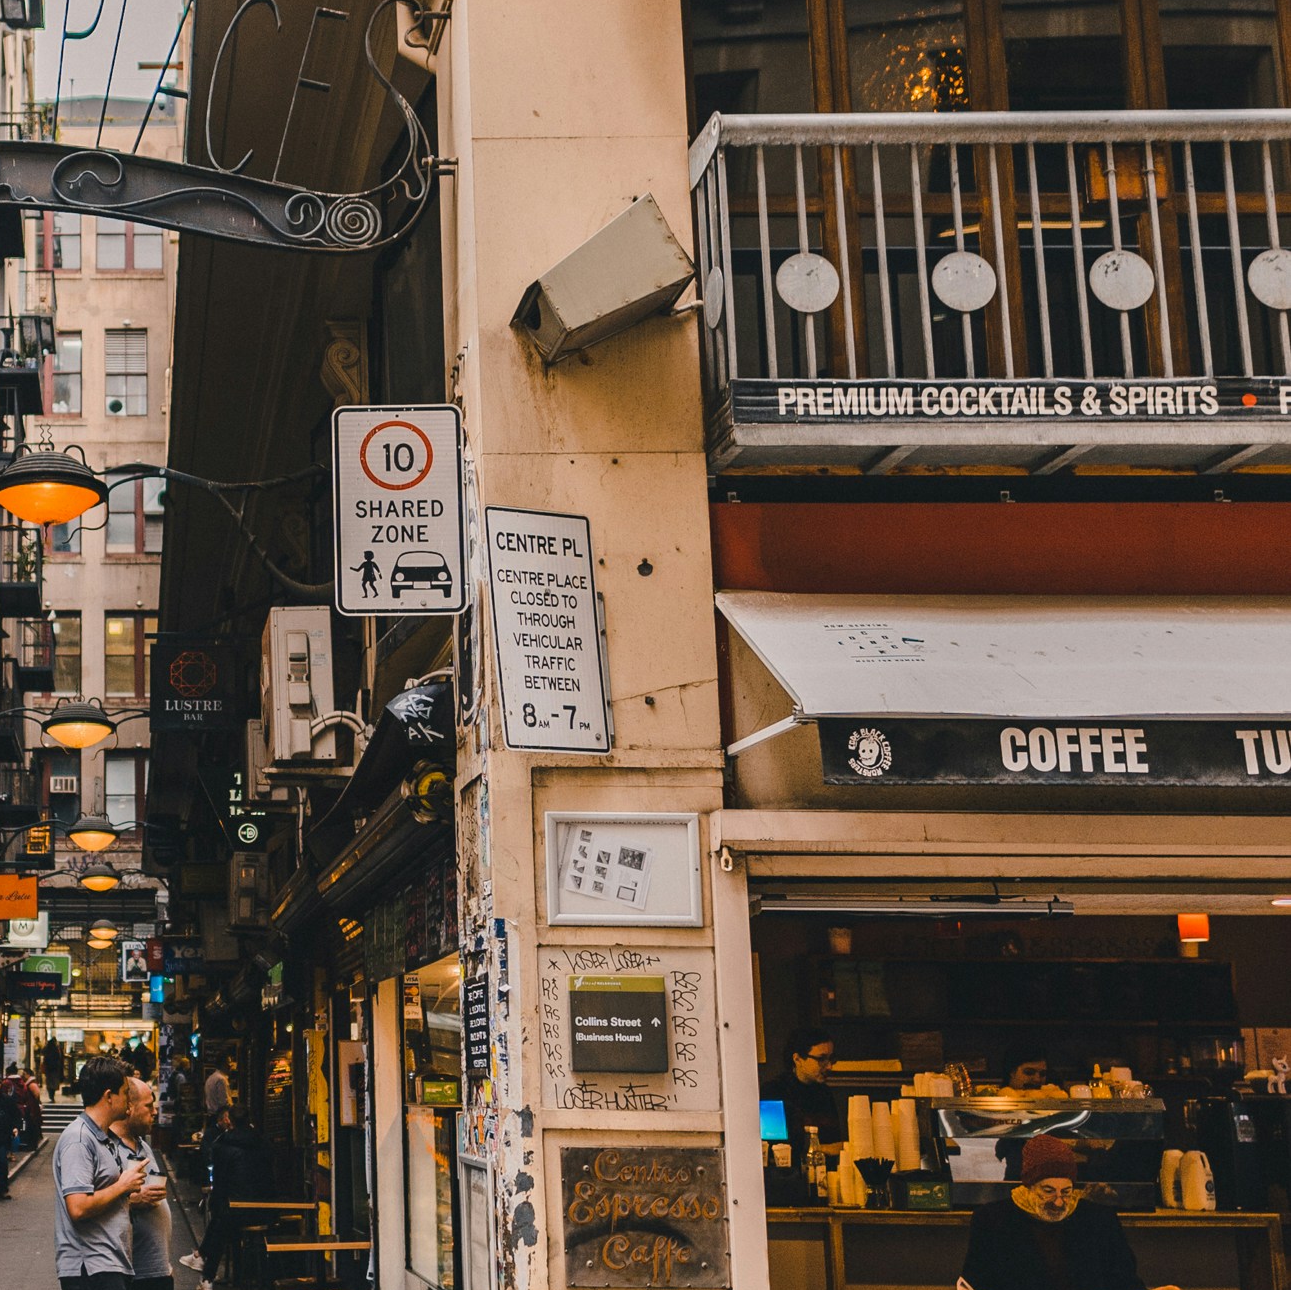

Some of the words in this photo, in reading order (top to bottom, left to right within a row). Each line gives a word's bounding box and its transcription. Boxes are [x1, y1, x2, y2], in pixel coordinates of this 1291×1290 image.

[778, 387, 914, 415] PREMIUM
[921, 386, 1072, 415] COCKTAILS
[1080, 386, 1103, 415] &
[1109, 386, 1219, 415] SPIRITS
[383, 443, 414, 472] 10
[355, 500, 444, 518] SHARED
[371, 525, 429, 543] ZONE
[496, 531, 557, 555] CENTRE
[562, 537, 583, 558] PL
[497, 569, 545, 586] CENTRE
[547, 573, 587, 589] PLACE
[510, 590, 559, 608] CLOSED
[561, 594, 578, 609] TO
[516, 611, 576, 629] THROUGH
[512, 632, 583, 651] VEHICULAR
[524, 655, 576, 671] TRAFFIC
[524, 675, 581, 692] BETWEEN
[165, 700, 222, 711] LUSTRE
[183, 713, 203, 721] BAR
[860, 728, 886, 742] BLACK
[882, 741, 892, 770] COFFEE
[1000, 727, 1149, 773] COFFEE
[1235, 729, 1291, 775] TU
[670, 971, 701, 991] RS
[672, 990, 697, 1011] RS
[575, 1016, 608, 1027] Collins
[610, 1017, 642, 1027] Street
[672, 1016, 699, 1036] RS
[576, 1032, 614, 1042] (Business
[615, 1032, 642, 1042] Hours)
[674, 1042, 696, 1061] RS
[672, 1068, 698, 1087] RS
[594, 1149, 691, 1183] Centro
[568, 1181, 720, 1227] Espresso
[602, 1235, 691, 1283] Caffe
